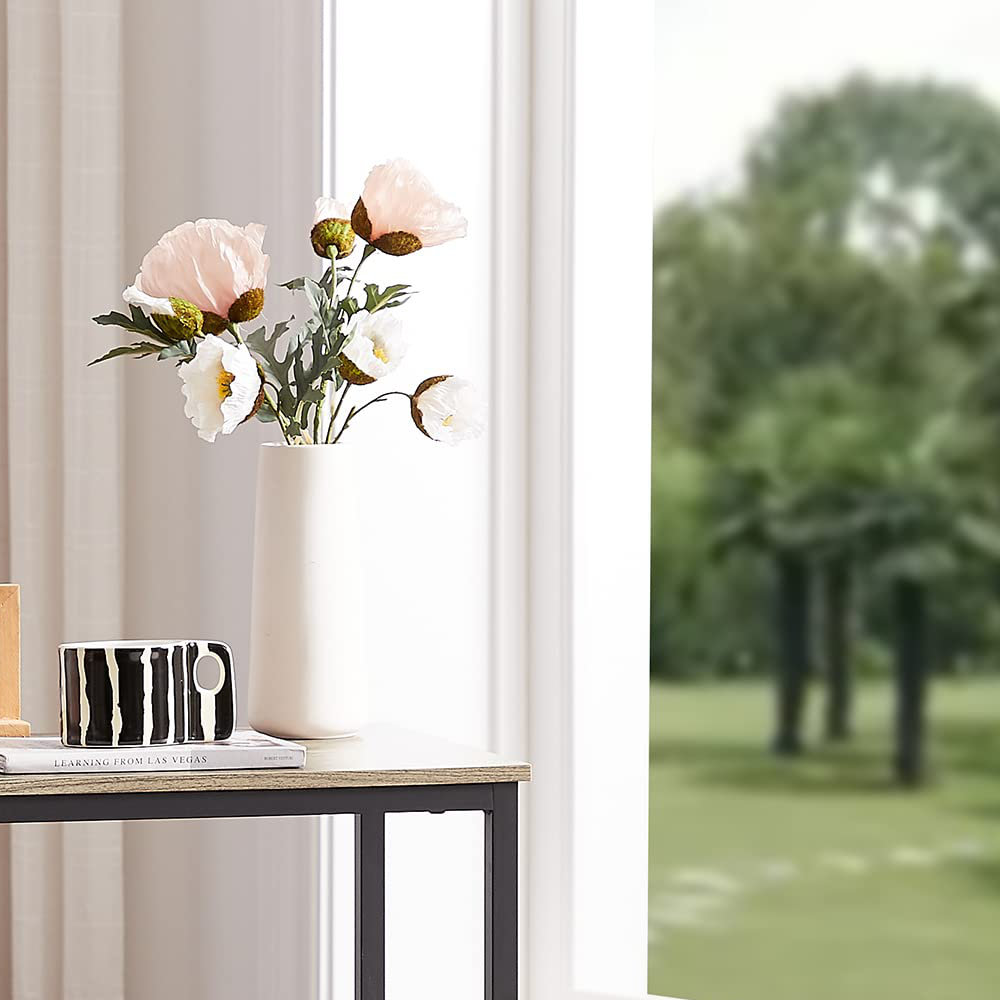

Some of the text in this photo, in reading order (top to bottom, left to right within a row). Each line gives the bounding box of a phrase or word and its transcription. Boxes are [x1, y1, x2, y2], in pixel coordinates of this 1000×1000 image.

[54, 755, 208, 768] LEARNING FROM LAS VEGAS
